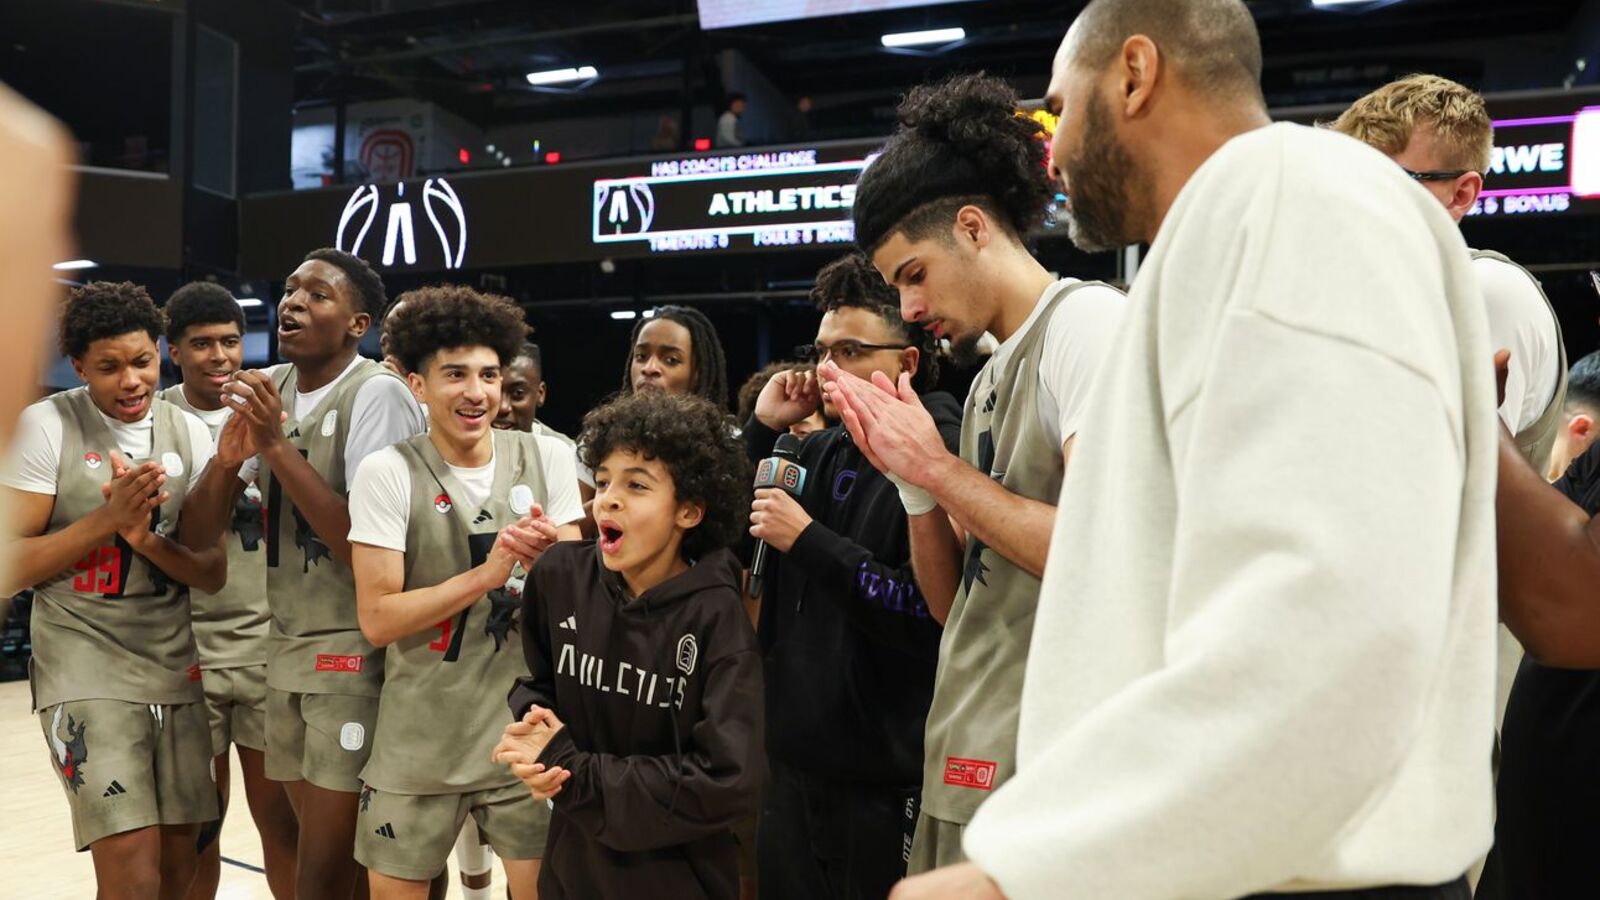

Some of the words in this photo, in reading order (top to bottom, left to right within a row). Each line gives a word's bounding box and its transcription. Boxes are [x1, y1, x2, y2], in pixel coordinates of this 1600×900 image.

[738, 150, 816, 172] CHALLENGE
[708, 184, 857, 216] ATHLETICS
[1504, 193, 1570, 214] BONUS
